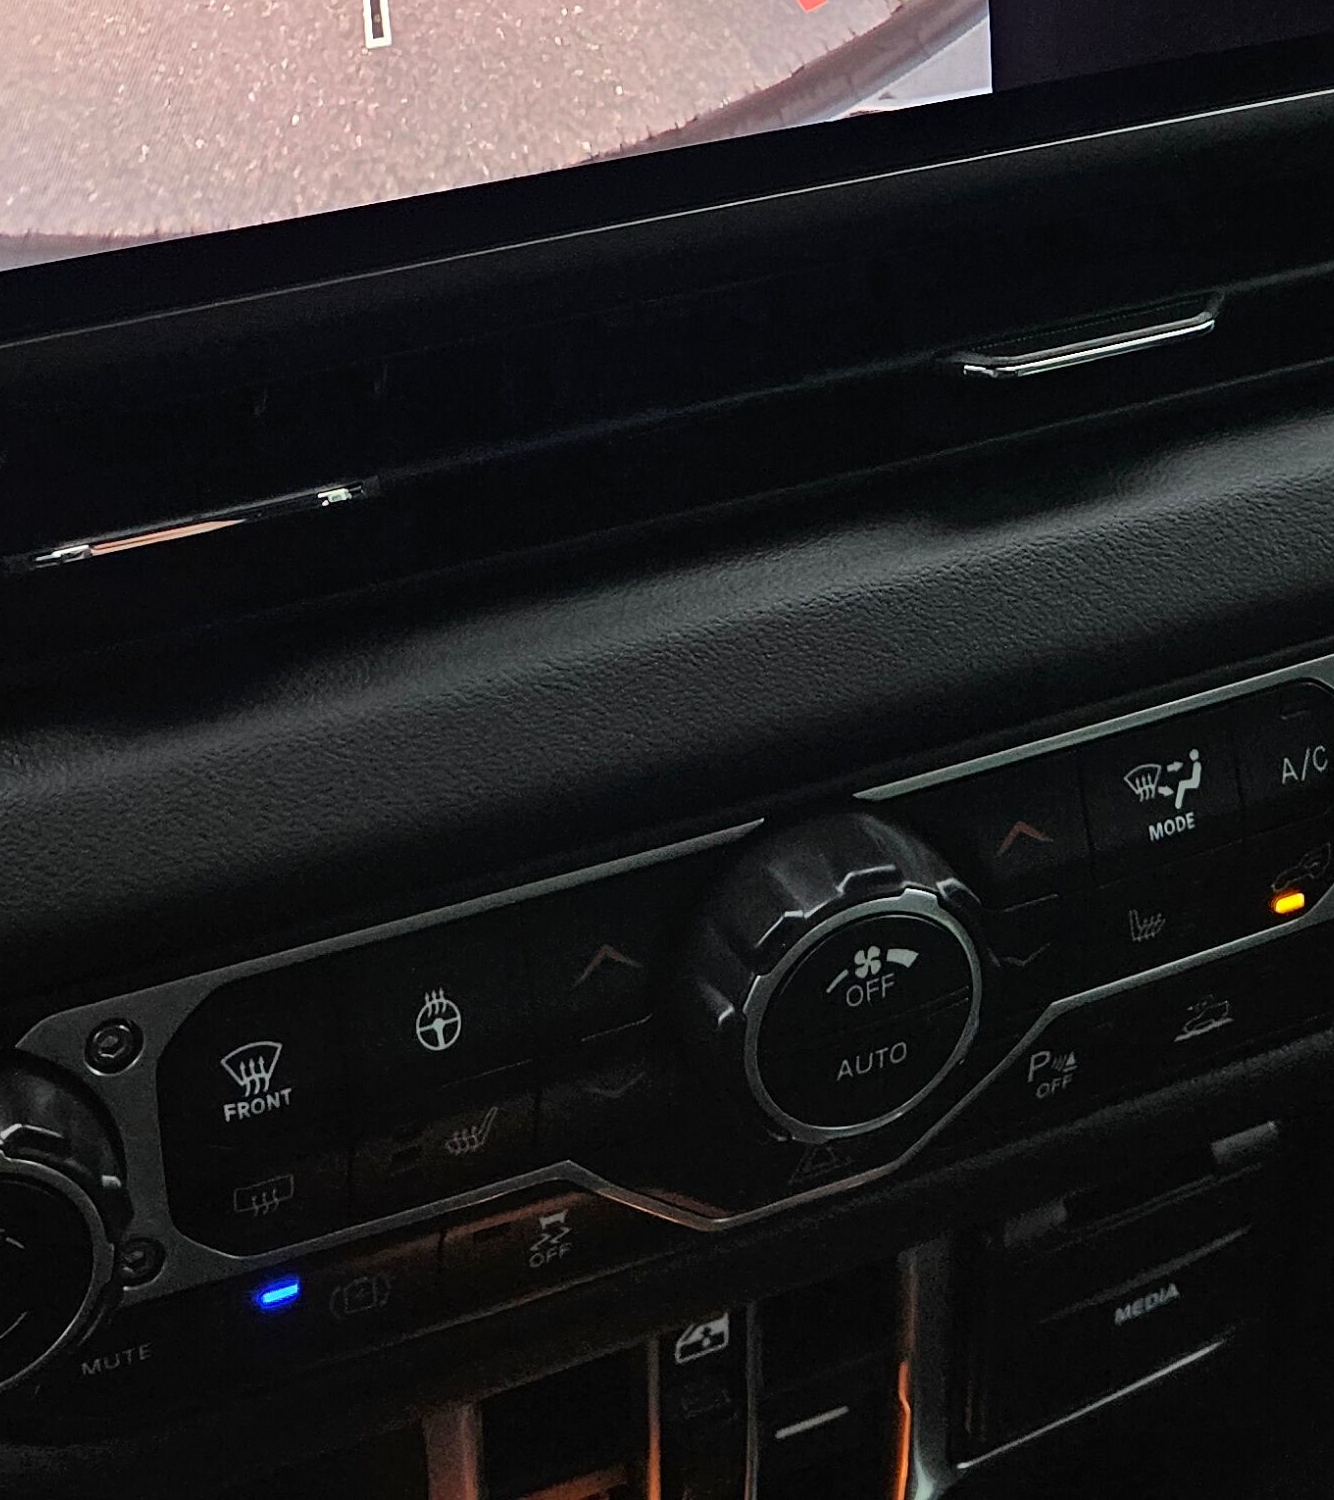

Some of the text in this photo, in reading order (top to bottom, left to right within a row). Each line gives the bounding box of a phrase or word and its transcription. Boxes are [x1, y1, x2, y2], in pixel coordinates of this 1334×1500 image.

[1280, 744, 1330, 785] A/C
[1148, 812, 1196, 842] MODE
[844, 972, 896, 1008] OFF
[835, 1041, 908, 1082] AUTO
[1035, 1073, 1075, 1100] OFF
[223, 1087, 292, 1123] FRONT
[528, 1242, 573, 1269] OFF
[1113, 1282, 1181, 1327] MEDIA
[81, 1342, 154, 1376] MUTE
